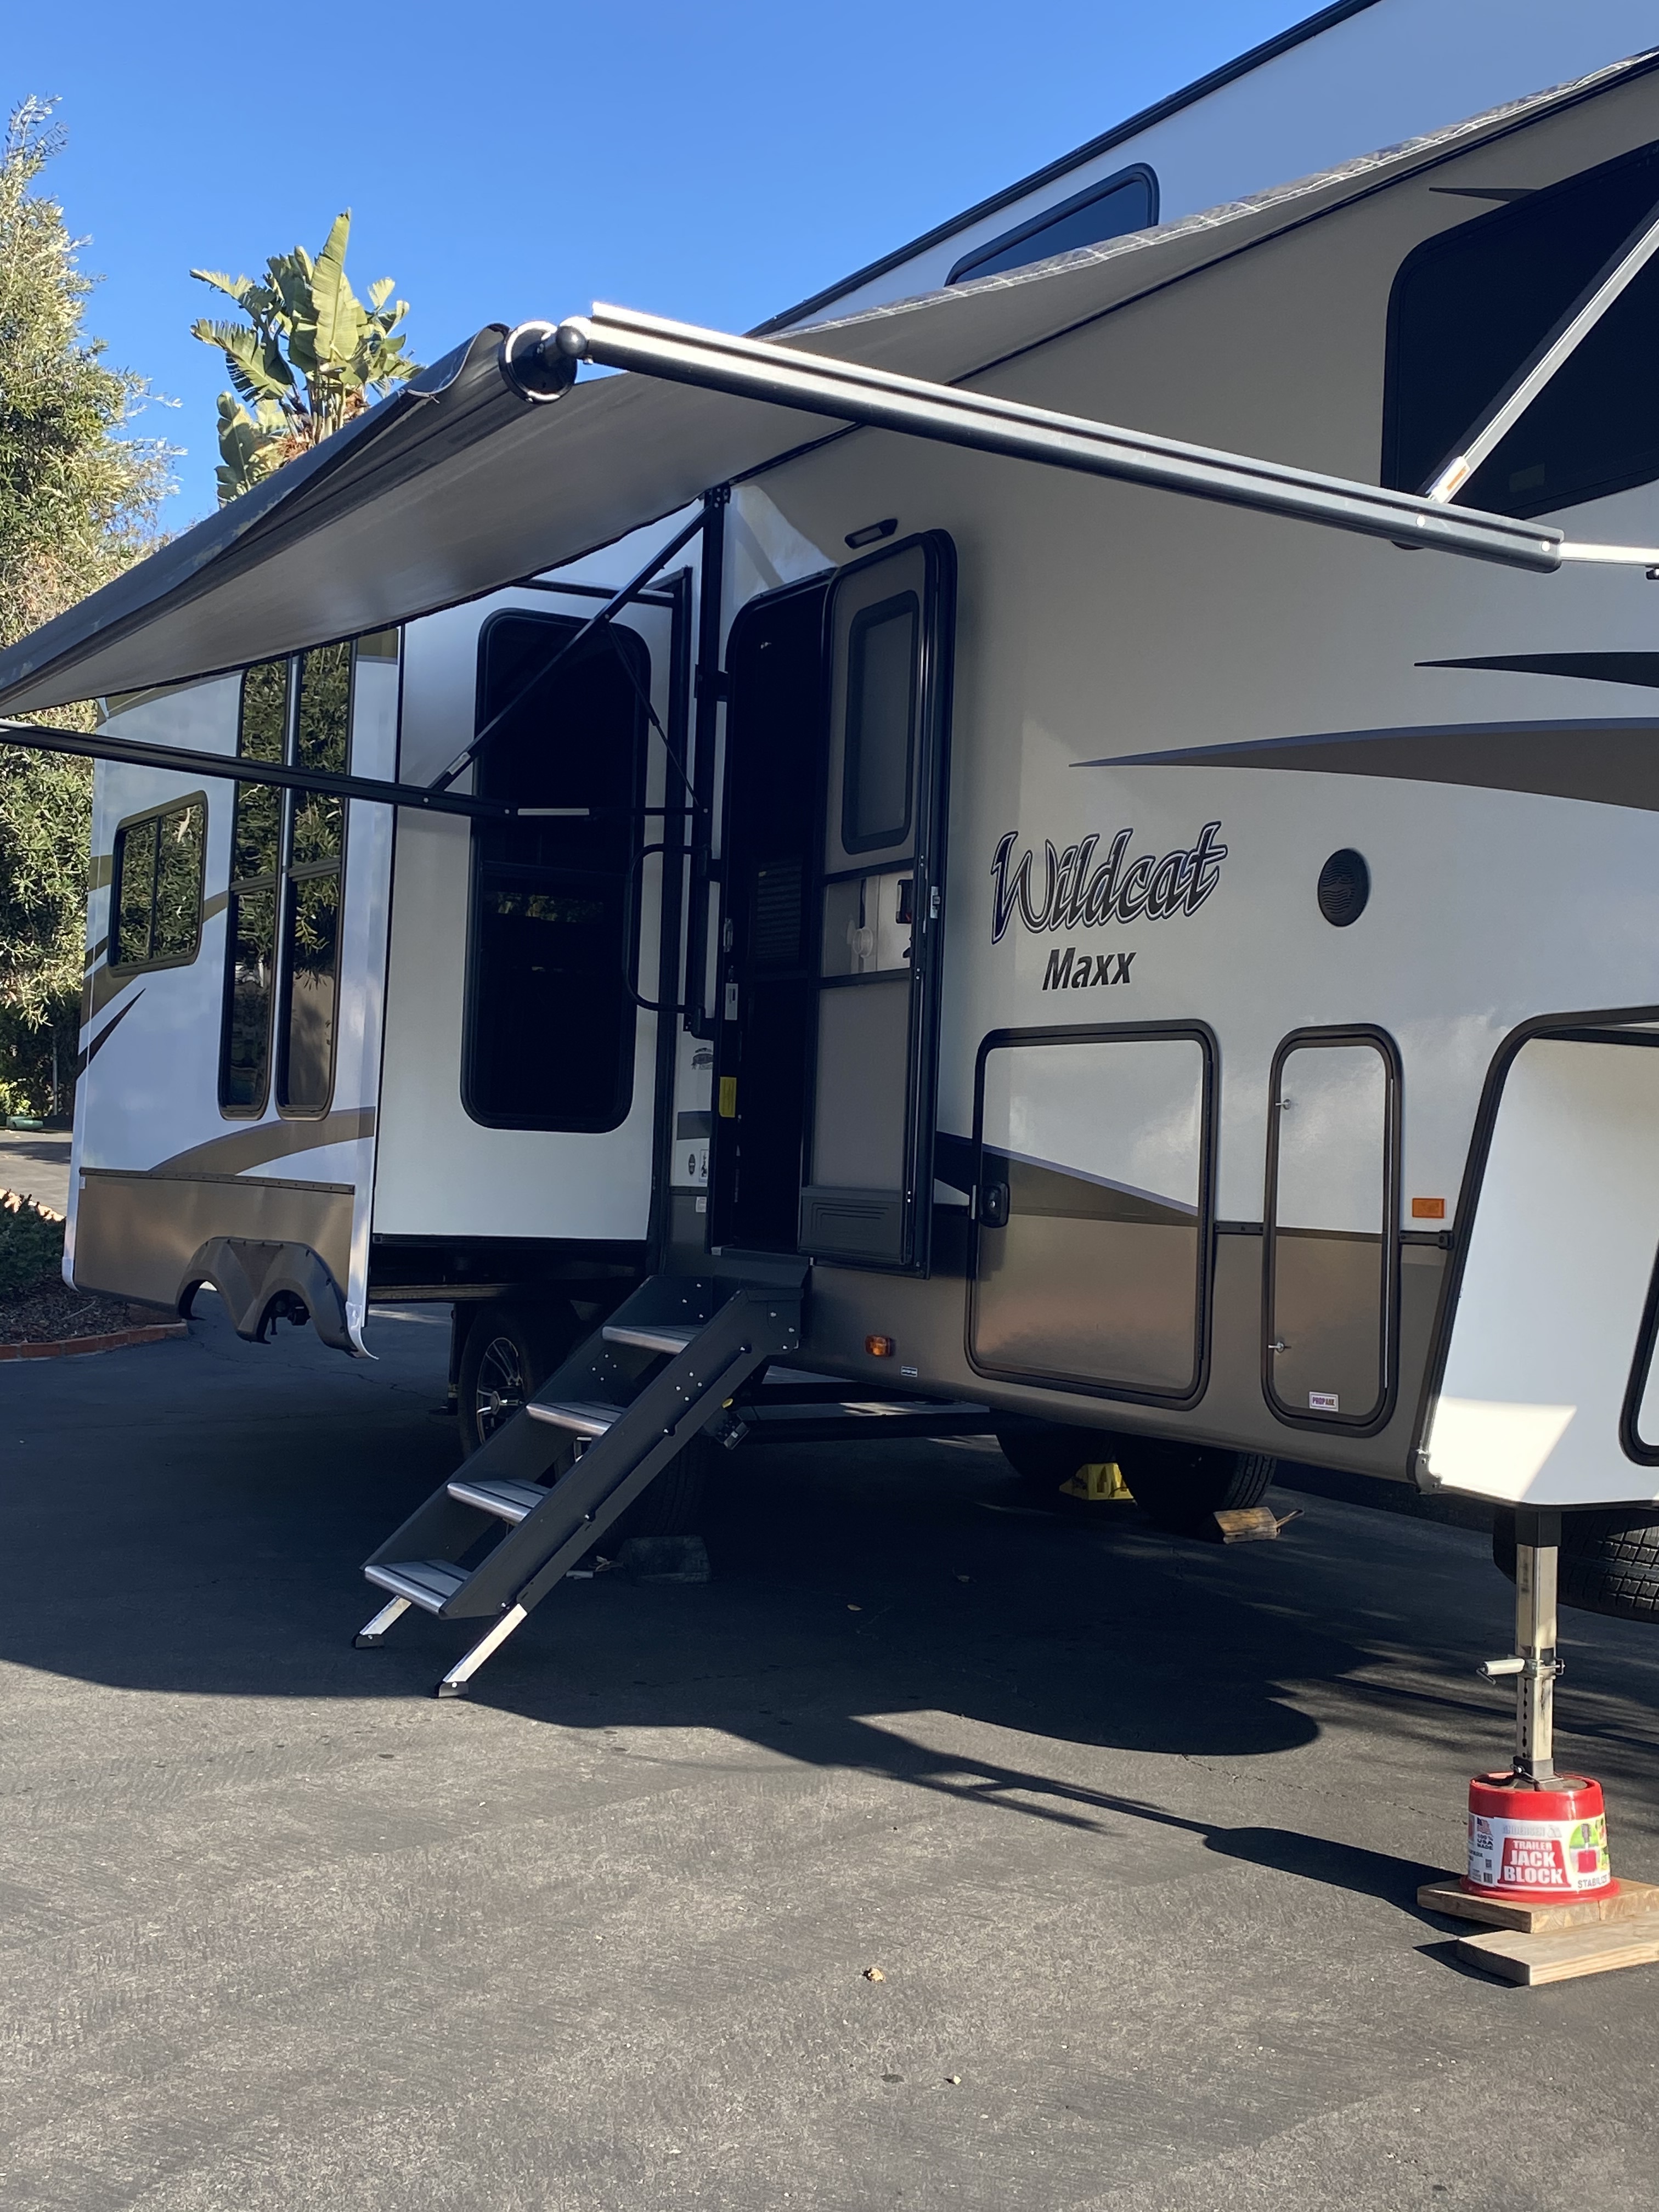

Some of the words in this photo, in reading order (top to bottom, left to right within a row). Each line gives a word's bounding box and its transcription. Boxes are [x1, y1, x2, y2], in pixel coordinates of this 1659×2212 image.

[990, 821, 1228, 945] Wildcat
[1042, 947, 1137, 991] Maxx
[1513, 1840, 1553, 1851] TRAILER
[1510, 1849, 1556, 1867] JACK
[1504, 1865, 1564, 1884] BLOCK
